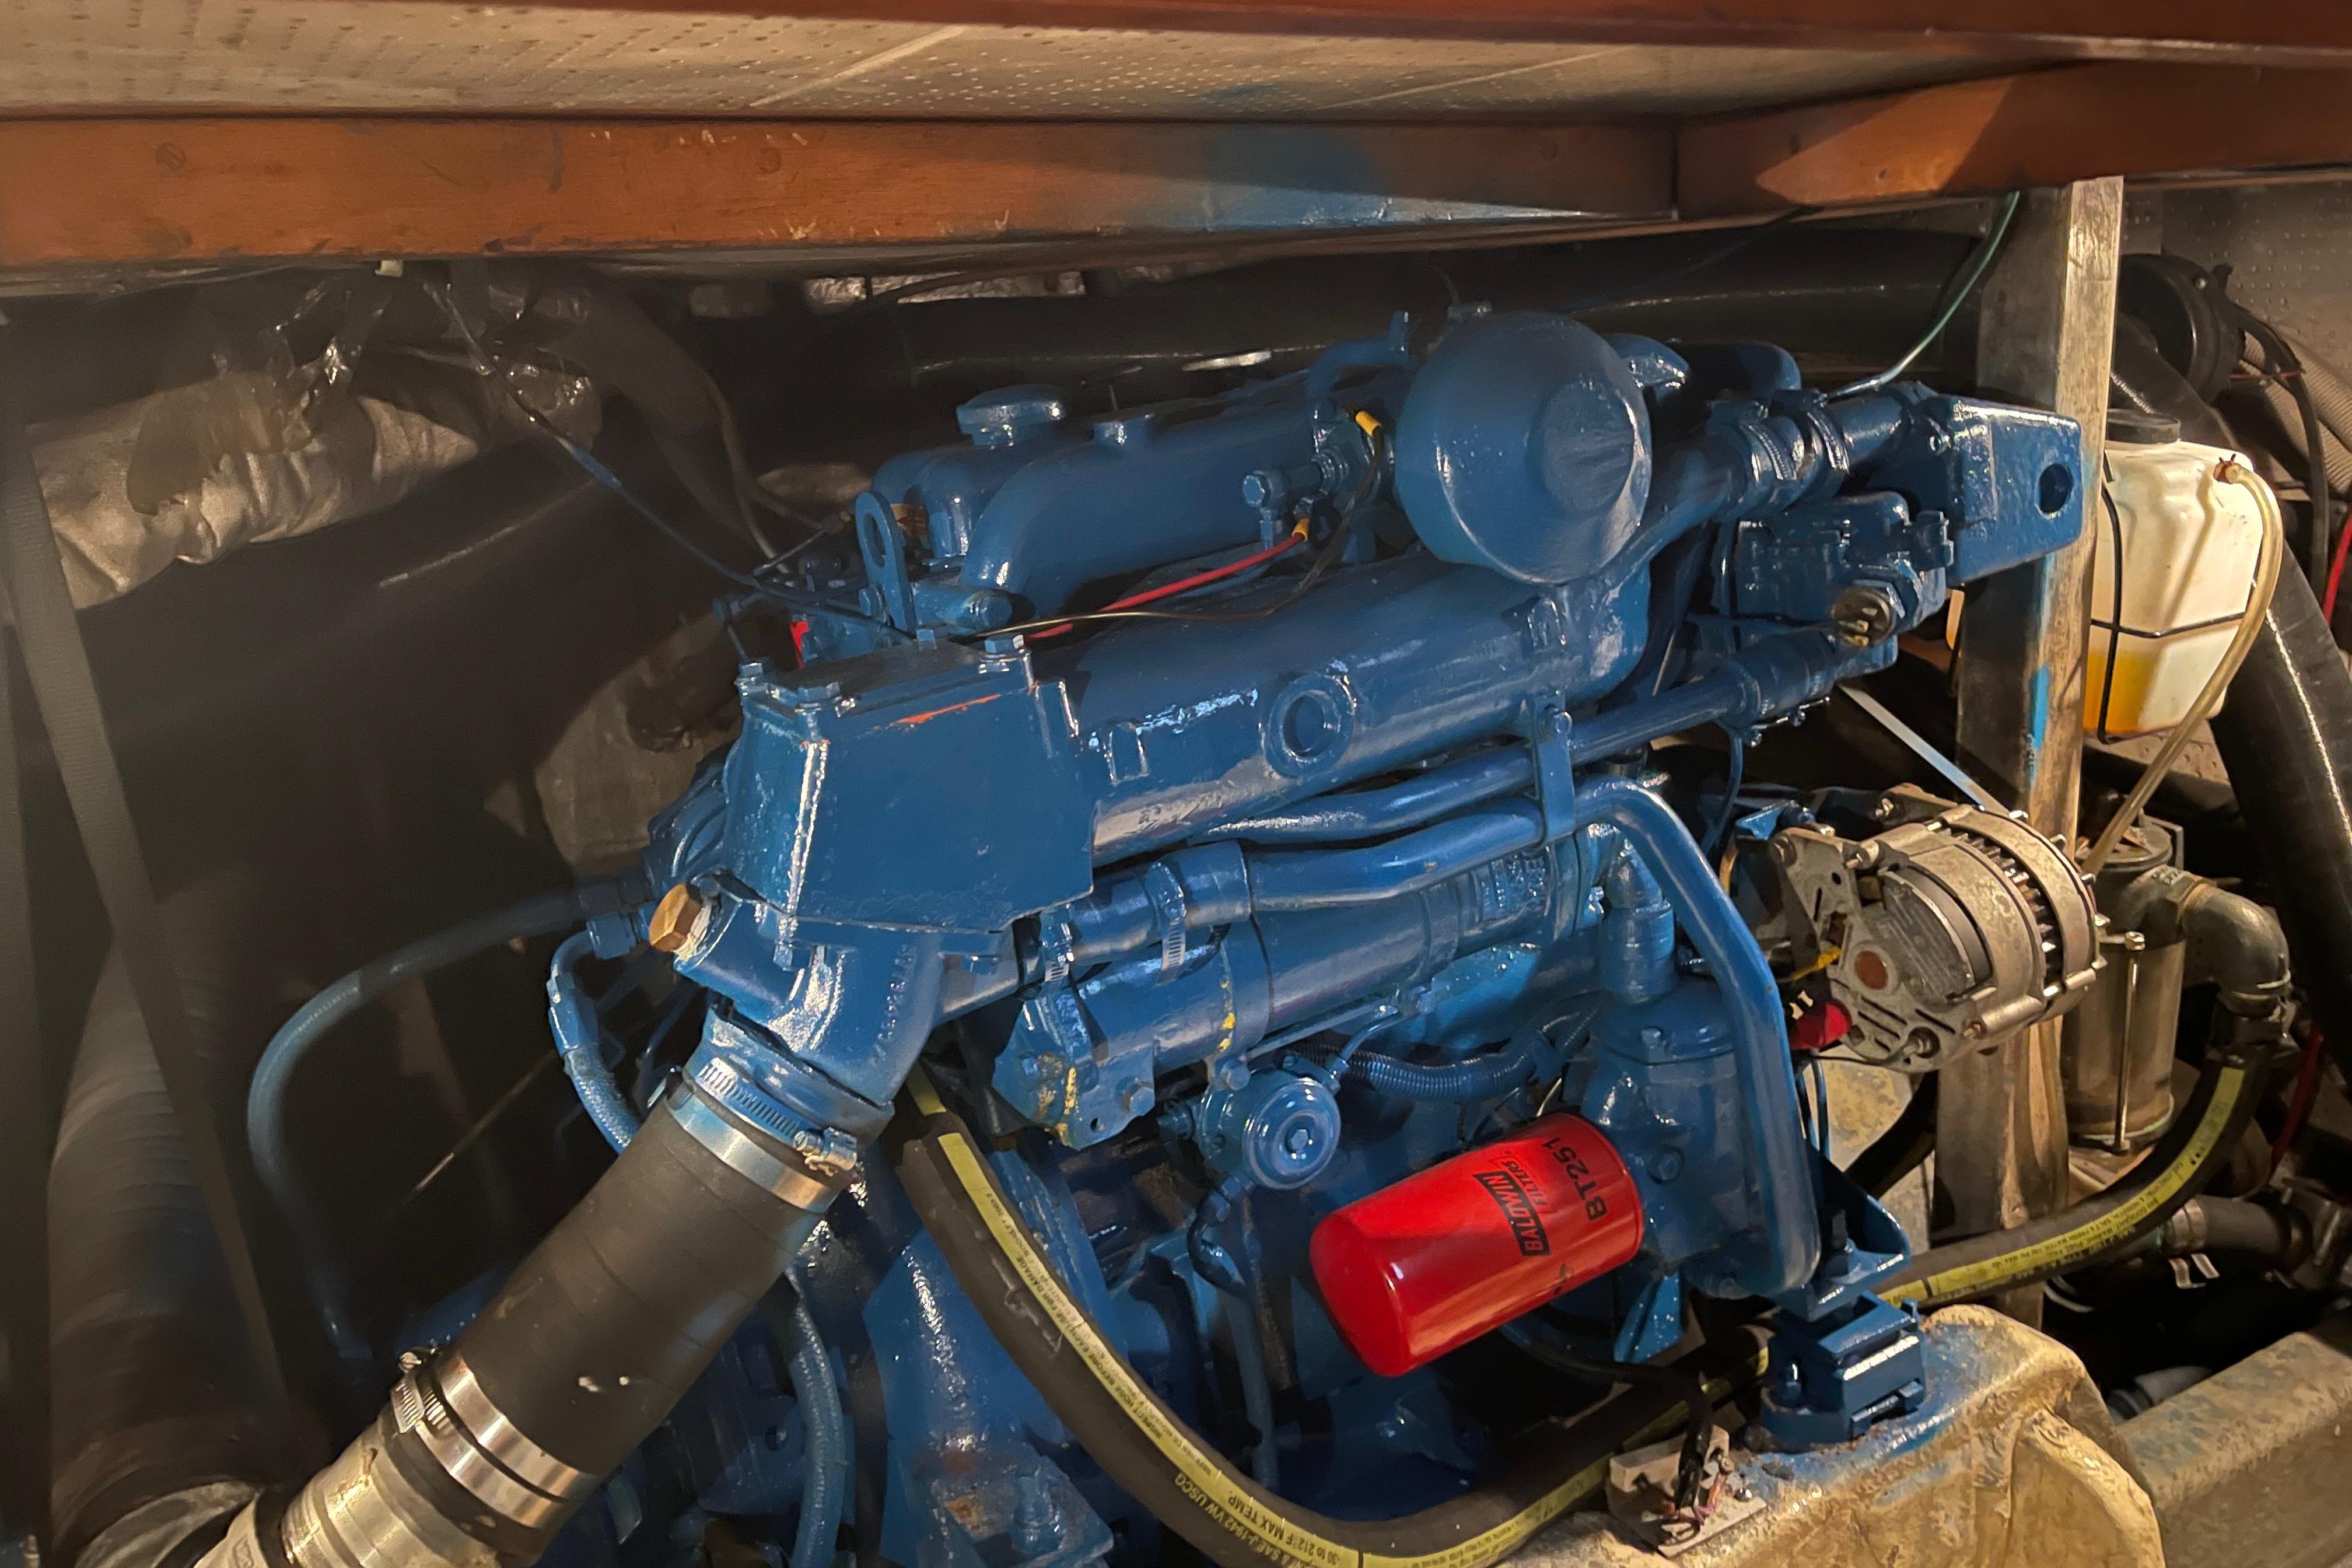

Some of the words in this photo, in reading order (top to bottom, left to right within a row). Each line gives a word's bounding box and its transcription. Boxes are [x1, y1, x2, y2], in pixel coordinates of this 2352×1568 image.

[1502, 1160, 1548, 1208] FILTERS
[1541, 1137, 1607, 1220] BT251
[1485, 1171, 1544, 1251] BALDWIN
[1014, 1254, 1045, 1293] DAMAGE
[1204, 1500, 1227, 1522] VW
[1222, 1515, 1260, 1548] J-1942
[1256, 1515, 1287, 1541] MAX
[1255, 1539, 1282, 1562] SAE
[1314, 1546, 1327, 1560] to
